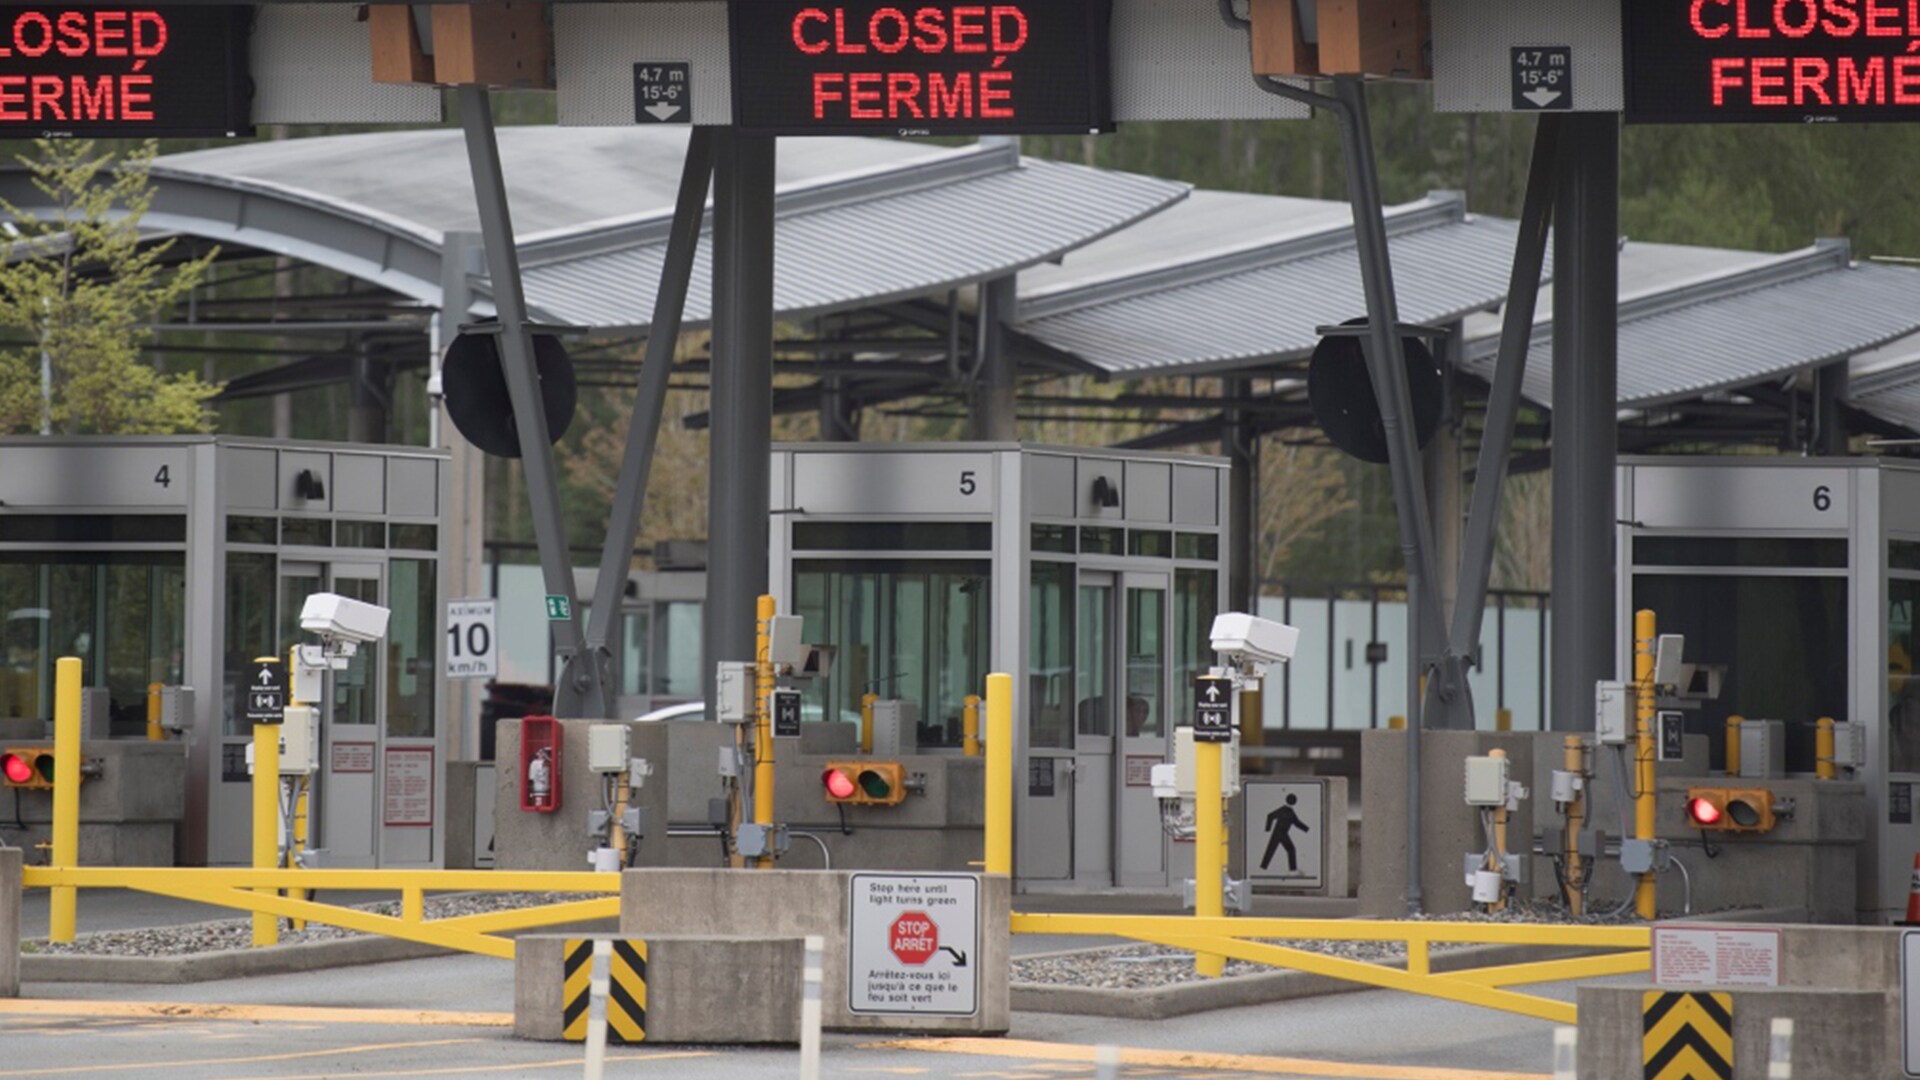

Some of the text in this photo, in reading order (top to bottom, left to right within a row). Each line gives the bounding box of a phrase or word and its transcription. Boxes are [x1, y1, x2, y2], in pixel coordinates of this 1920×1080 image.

[0, 11, 167, 57] OSED
[792, 6, 1028, 54] CLOSED
[1517, 51, 1565, 66] 4.7 m
[639, 67, 684, 81] 4.7 m
[1711, 40, 1920, 106] FERMÉ
[812, 57, 1014, 119] FERMÉ
[154, 465, 171, 488] 4
[959, 472, 976, 496] 5
[1813, 485, 1832, 511] 6
[447, 622, 490, 657] 10
[448, 660, 488, 673] km/h
[869, 883, 948, 894] Stop here until
[869, 894, 957, 906] light turns green
[897, 920, 930, 936] STOP
[938, 971, 951, 980] ici
[908, 983, 921, 991] ce
[925, 983, 945, 993] que
[948, 983, 958, 992] le
[868, 993, 932, 1003] feu soit vert
